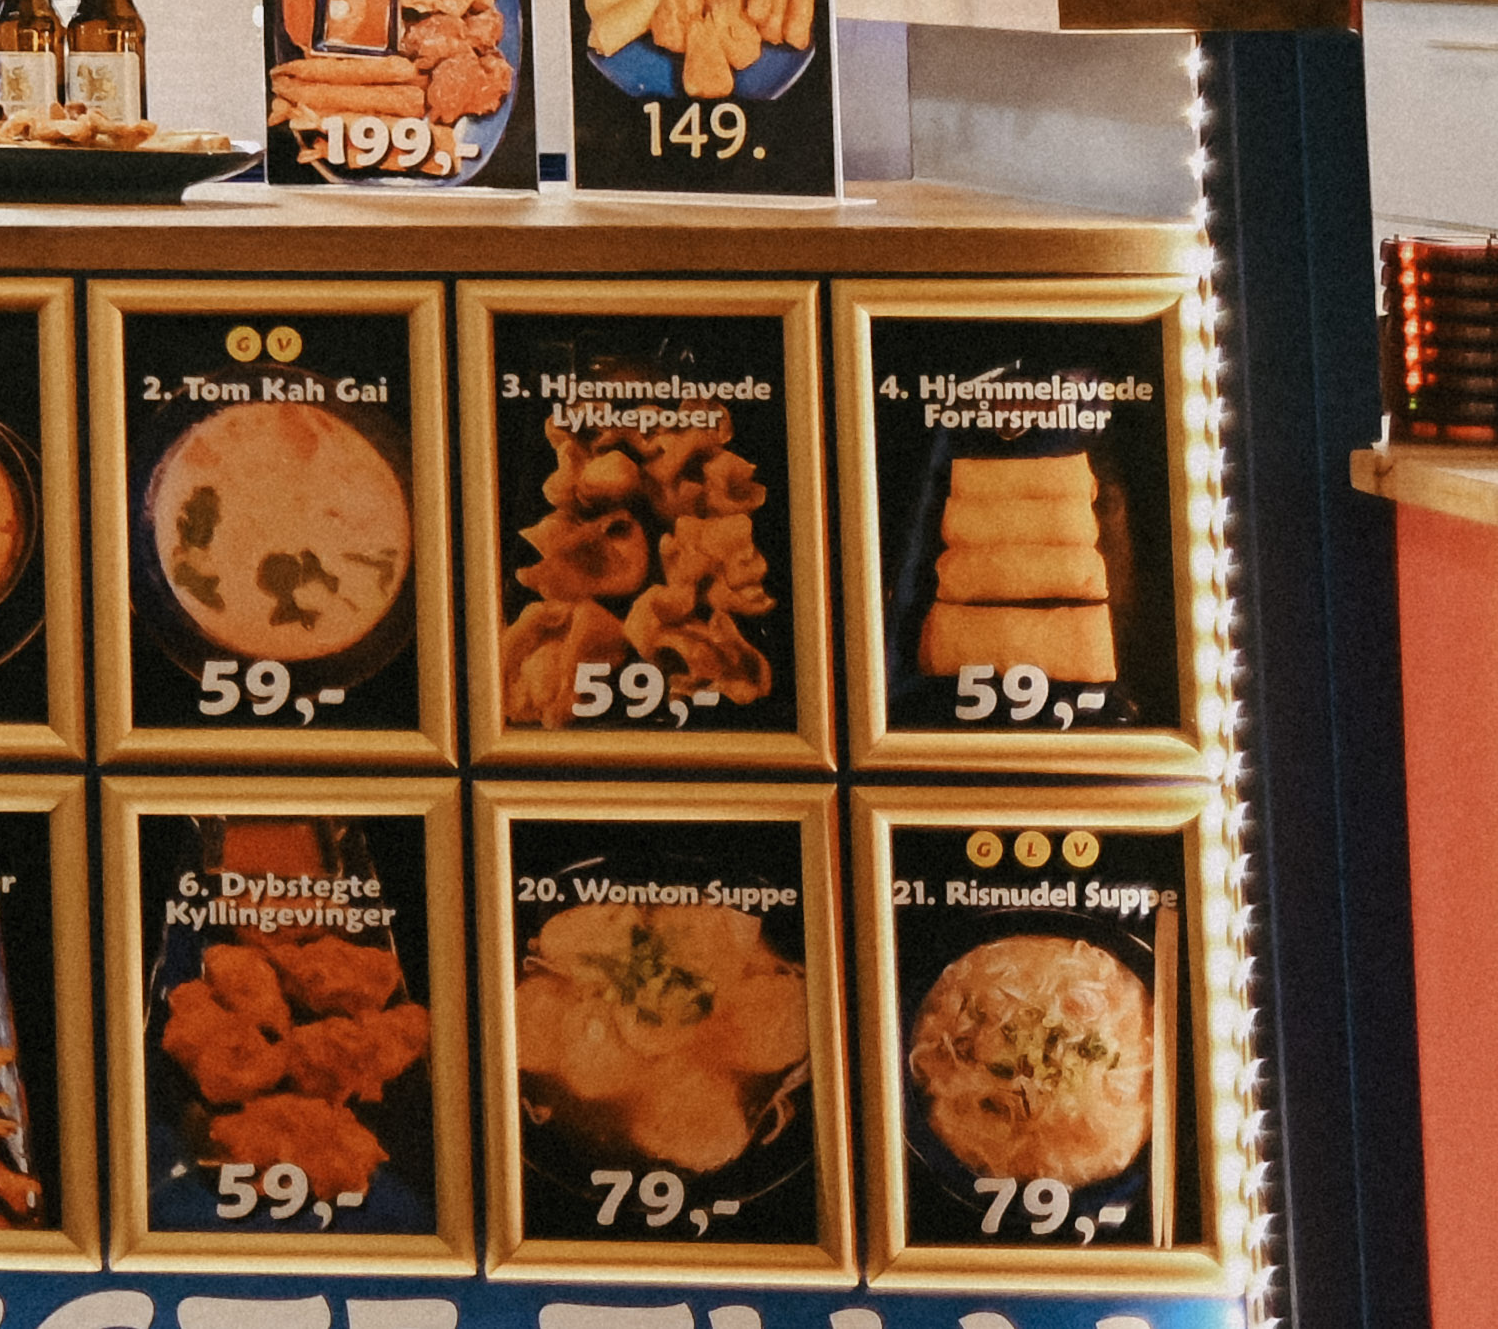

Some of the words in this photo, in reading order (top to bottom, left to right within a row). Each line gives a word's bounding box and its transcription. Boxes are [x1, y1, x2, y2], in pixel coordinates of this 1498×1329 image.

[326, 116, 479, 175] 199,-
[142, 377, 173, 403] 2.
[184, 376, 251, 403] Tom
[260, 376, 325, 403] Kah
[335, 378, 388, 404] Gai
[502, 376, 530, 401] 3.
[541, 373, 771, 408] Hjemmelavede
[878, 378, 909, 401] 4.
[920, 375, 1153, 408] Hjemmelavede
[553, 403, 724, 434] Lykkeposer
[925, 403, 1111, 431] Forårsruller
[198, 661, 346, 726] 59,-
[571, 663, 720, 729] 59,-
[955, 665, 1106, 731] 59,-
[179, 872, 209, 897] 6.
[221, 872, 381, 904] Dybstegte
[518, 878, 565, 903] 20.
[574, 880, 698, 905] Wonton
[707, 881, 797, 911] Suppe
[945, 881, 1076, 909] Risnudel
[1083, 882, 1178, 916] Suppe
[165, 900, 396, 932] Kyllingevinger
[215, 1163, 364, 1231] 59,-
[591, 1171, 741, 1237] 79,-
[974, 1178, 1127, 1243] 79,-
